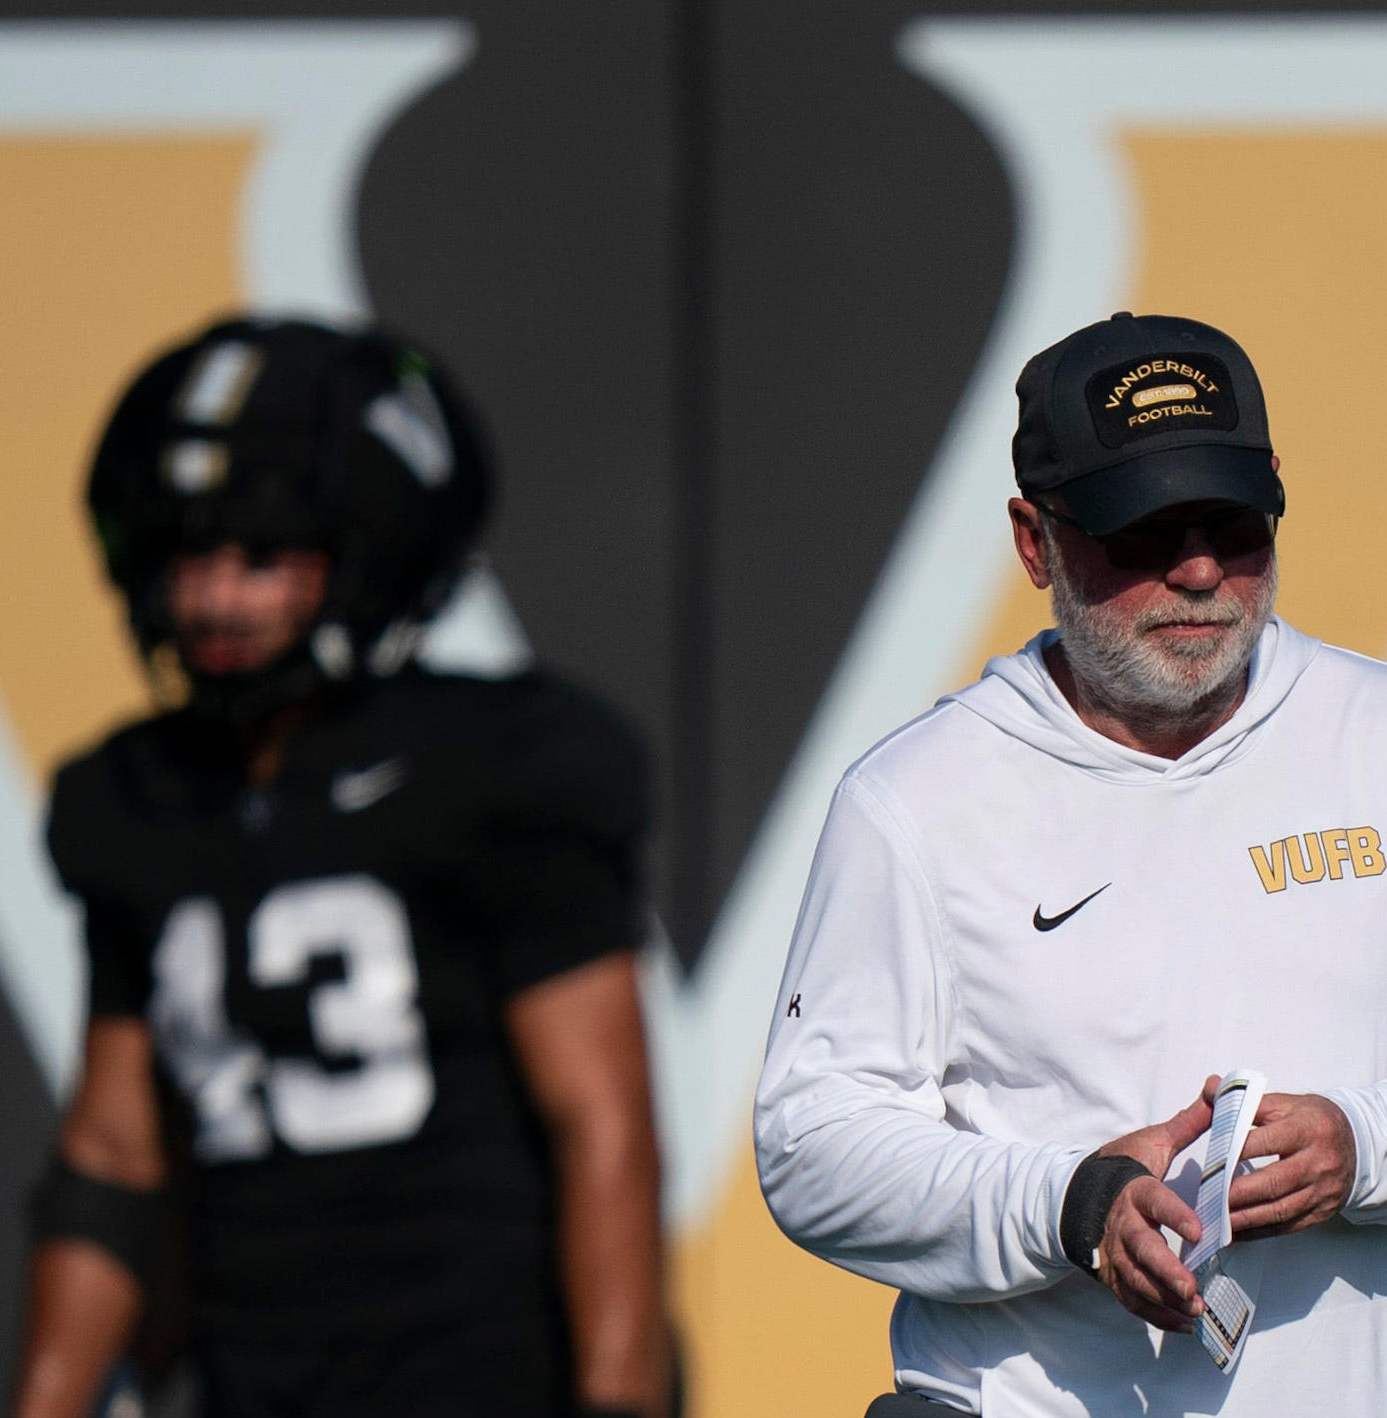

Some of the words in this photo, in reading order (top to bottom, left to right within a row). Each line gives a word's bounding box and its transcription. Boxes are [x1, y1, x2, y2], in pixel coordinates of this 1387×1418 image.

[1105, 360, 1219, 408] VANDERBILT
[1128, 404, 1213, 428] FOOTBALL
[1248, 826, 1387, 894] VUFB
